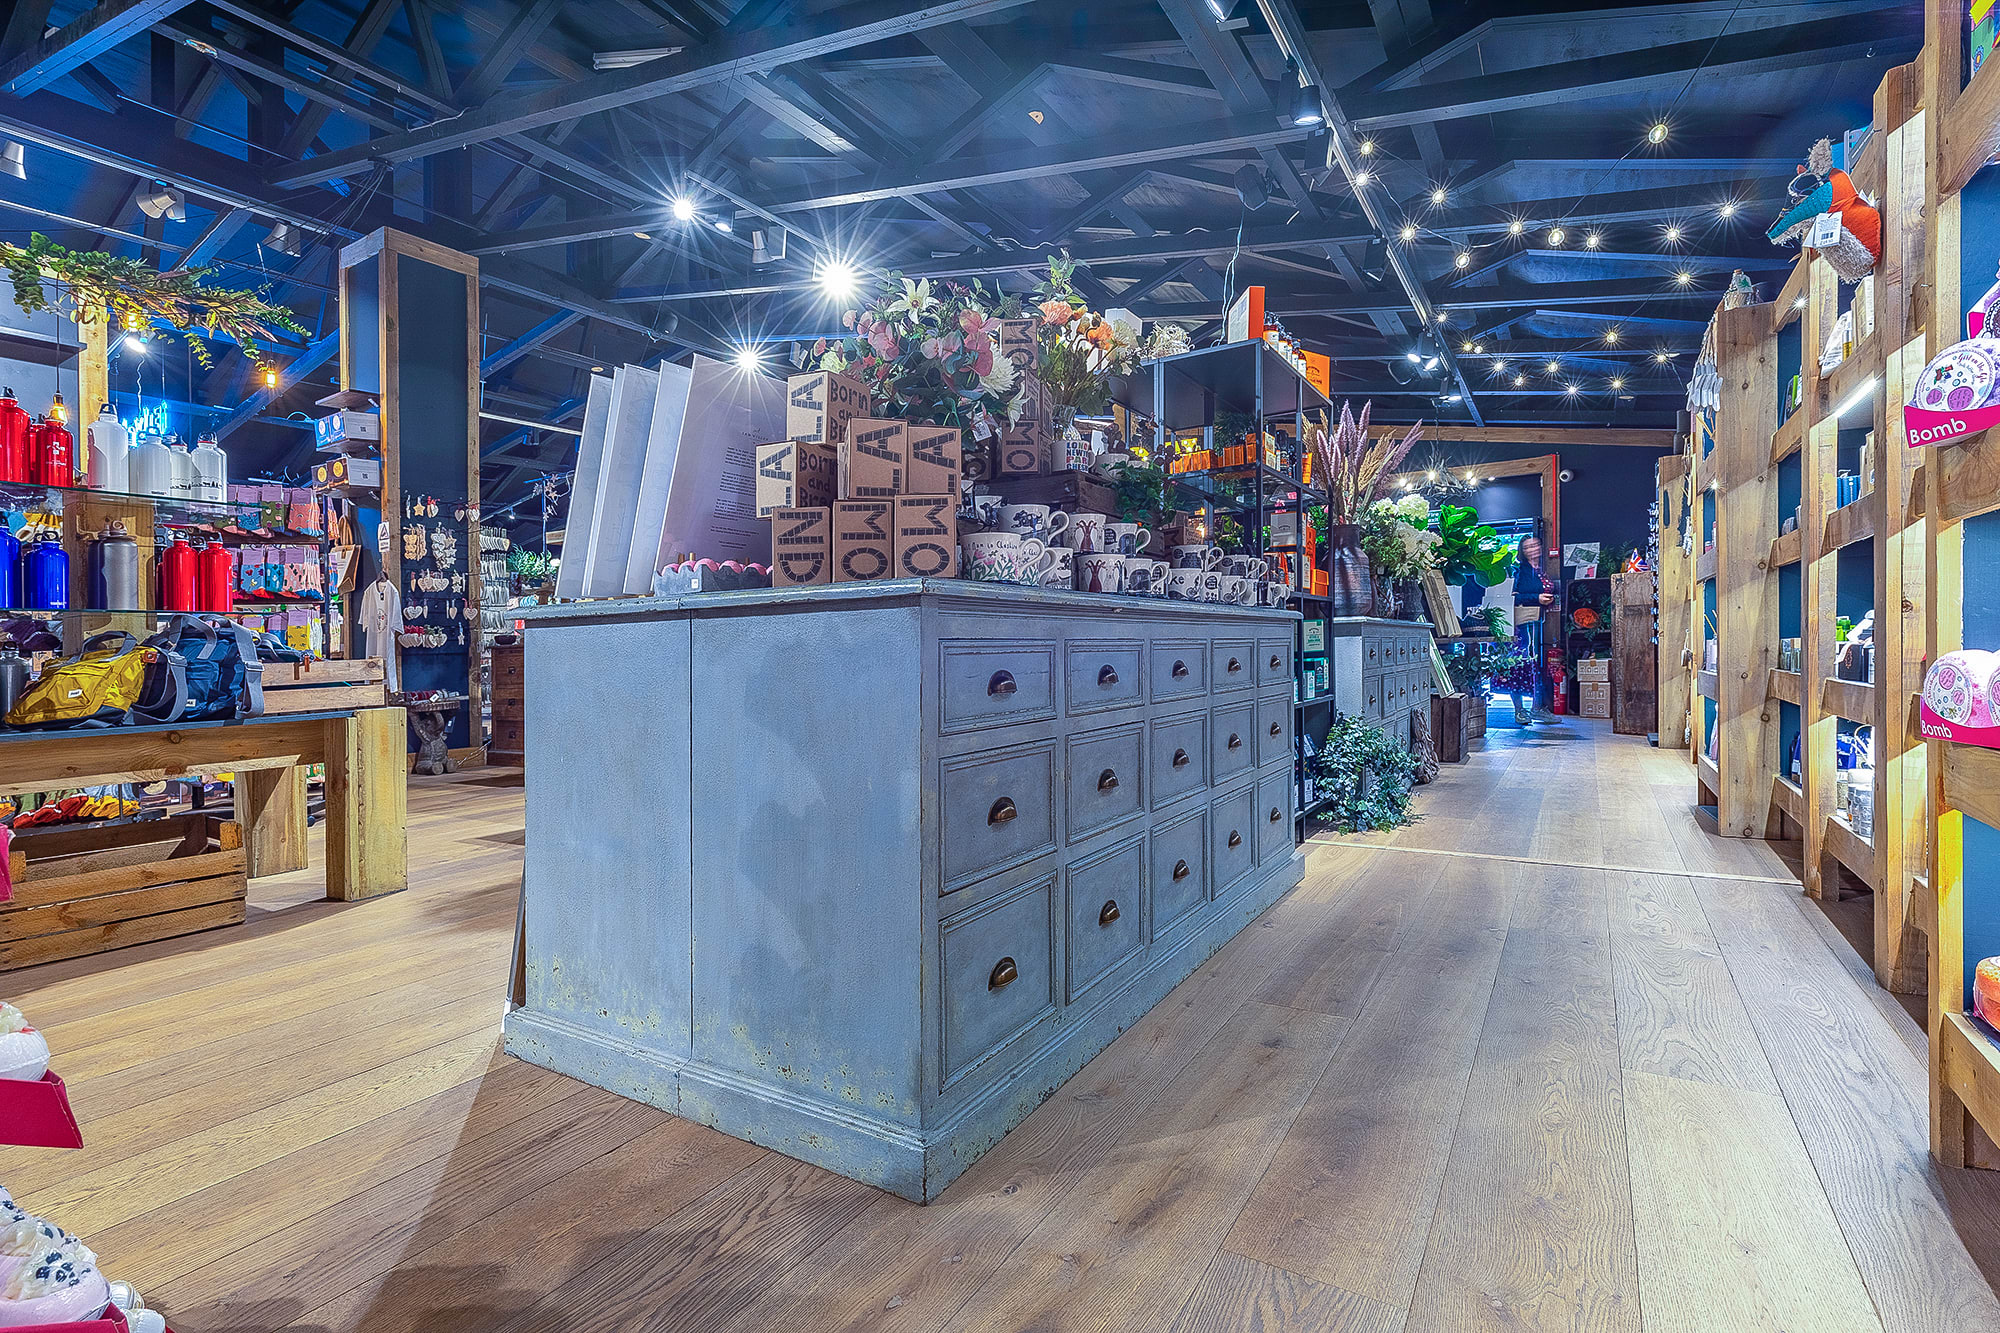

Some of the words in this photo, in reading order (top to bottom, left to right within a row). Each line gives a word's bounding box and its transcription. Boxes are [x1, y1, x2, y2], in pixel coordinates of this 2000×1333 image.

[830, 378, 868, 411] Born
[1908, 417, 1967, 445] Bomb
[808, 477, 831, 493] and
[1921, 719, 1953, 739] Bomb
